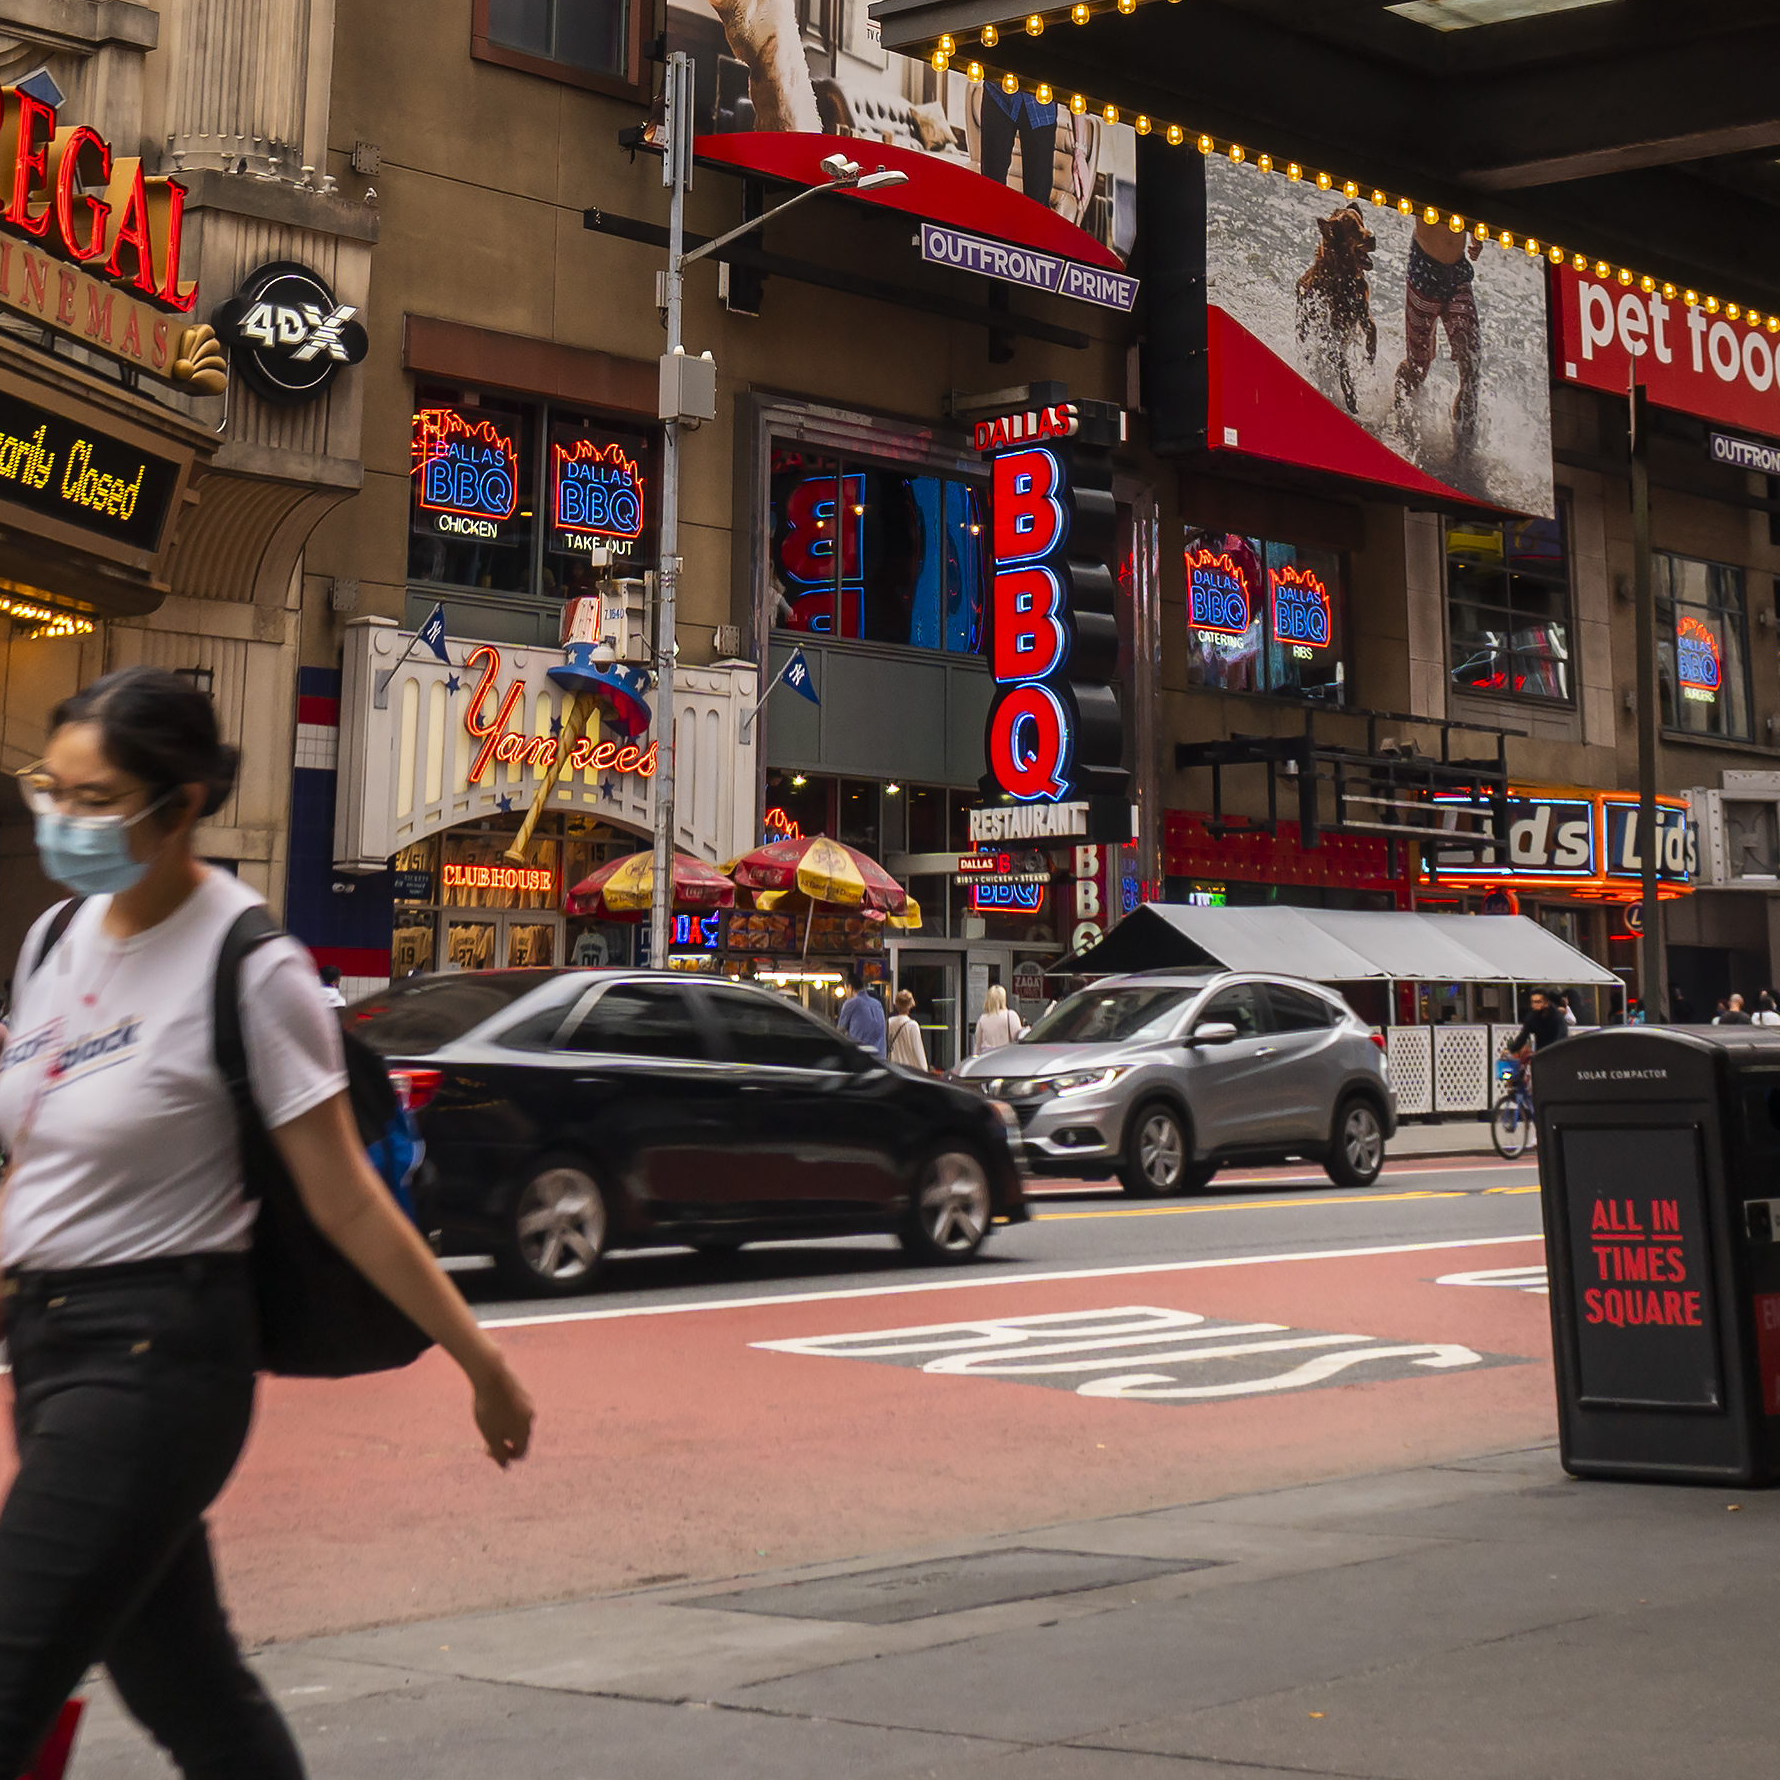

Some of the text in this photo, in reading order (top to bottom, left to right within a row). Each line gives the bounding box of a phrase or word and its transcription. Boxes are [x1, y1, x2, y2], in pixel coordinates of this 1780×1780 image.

[929, 230, 1131, 307] OUTFRONT PRIME
[237, 302, 361, 364] 4DX
[1578, 279, 1673, 365] pet
[974, 403, 1075, 451] DALLAS
[435, 440, 505, 467] DALLAS
[61, 439, 146, 522] Closed
[426, 458, 513, 515] BBQ
[567, 461, 633, 488] DALLAS
[560, 480, 641, 533] BBQ
[437, 514, 499, 539] CHICKEN
[565, 533, 634, 556] TAKE OUT
[1193, 569, 1241, 592] DALLAS
[1278, 585, 1322, 606] DALLAS
[990, 447, 1077, 802] BBQ
[1191, 585, 1247, 631] BBQ
[1275, 600, 1328, 643] BBQ
[1198, 629, 1244, 649] CATERING
[1292, 644, 1314, 661] RIBS
[1677, 636, 1712, 654] DALLAS
[1677, 650, 1719, 686] BBQ
[970, 800, 1090, 842] RESTAURANT
[442, 863, 553, 892] CLUBHOUSE
[960, 857, 994, 870] DALLAS
[980, 874, 1014, 884] CHICKEN
[1020, 873, 1049, 883] STEAKS
[1576, 1068, 1668, 1081] SOLAR COMPACTOR
[1591, 1199, 1680, 1232] ALL IN
[1591, 1246, 1687, 1283] TIMES
[1584, 1287, 1703, 1327] SQUARE
[745, 1304, 1484, 1400] BUS
